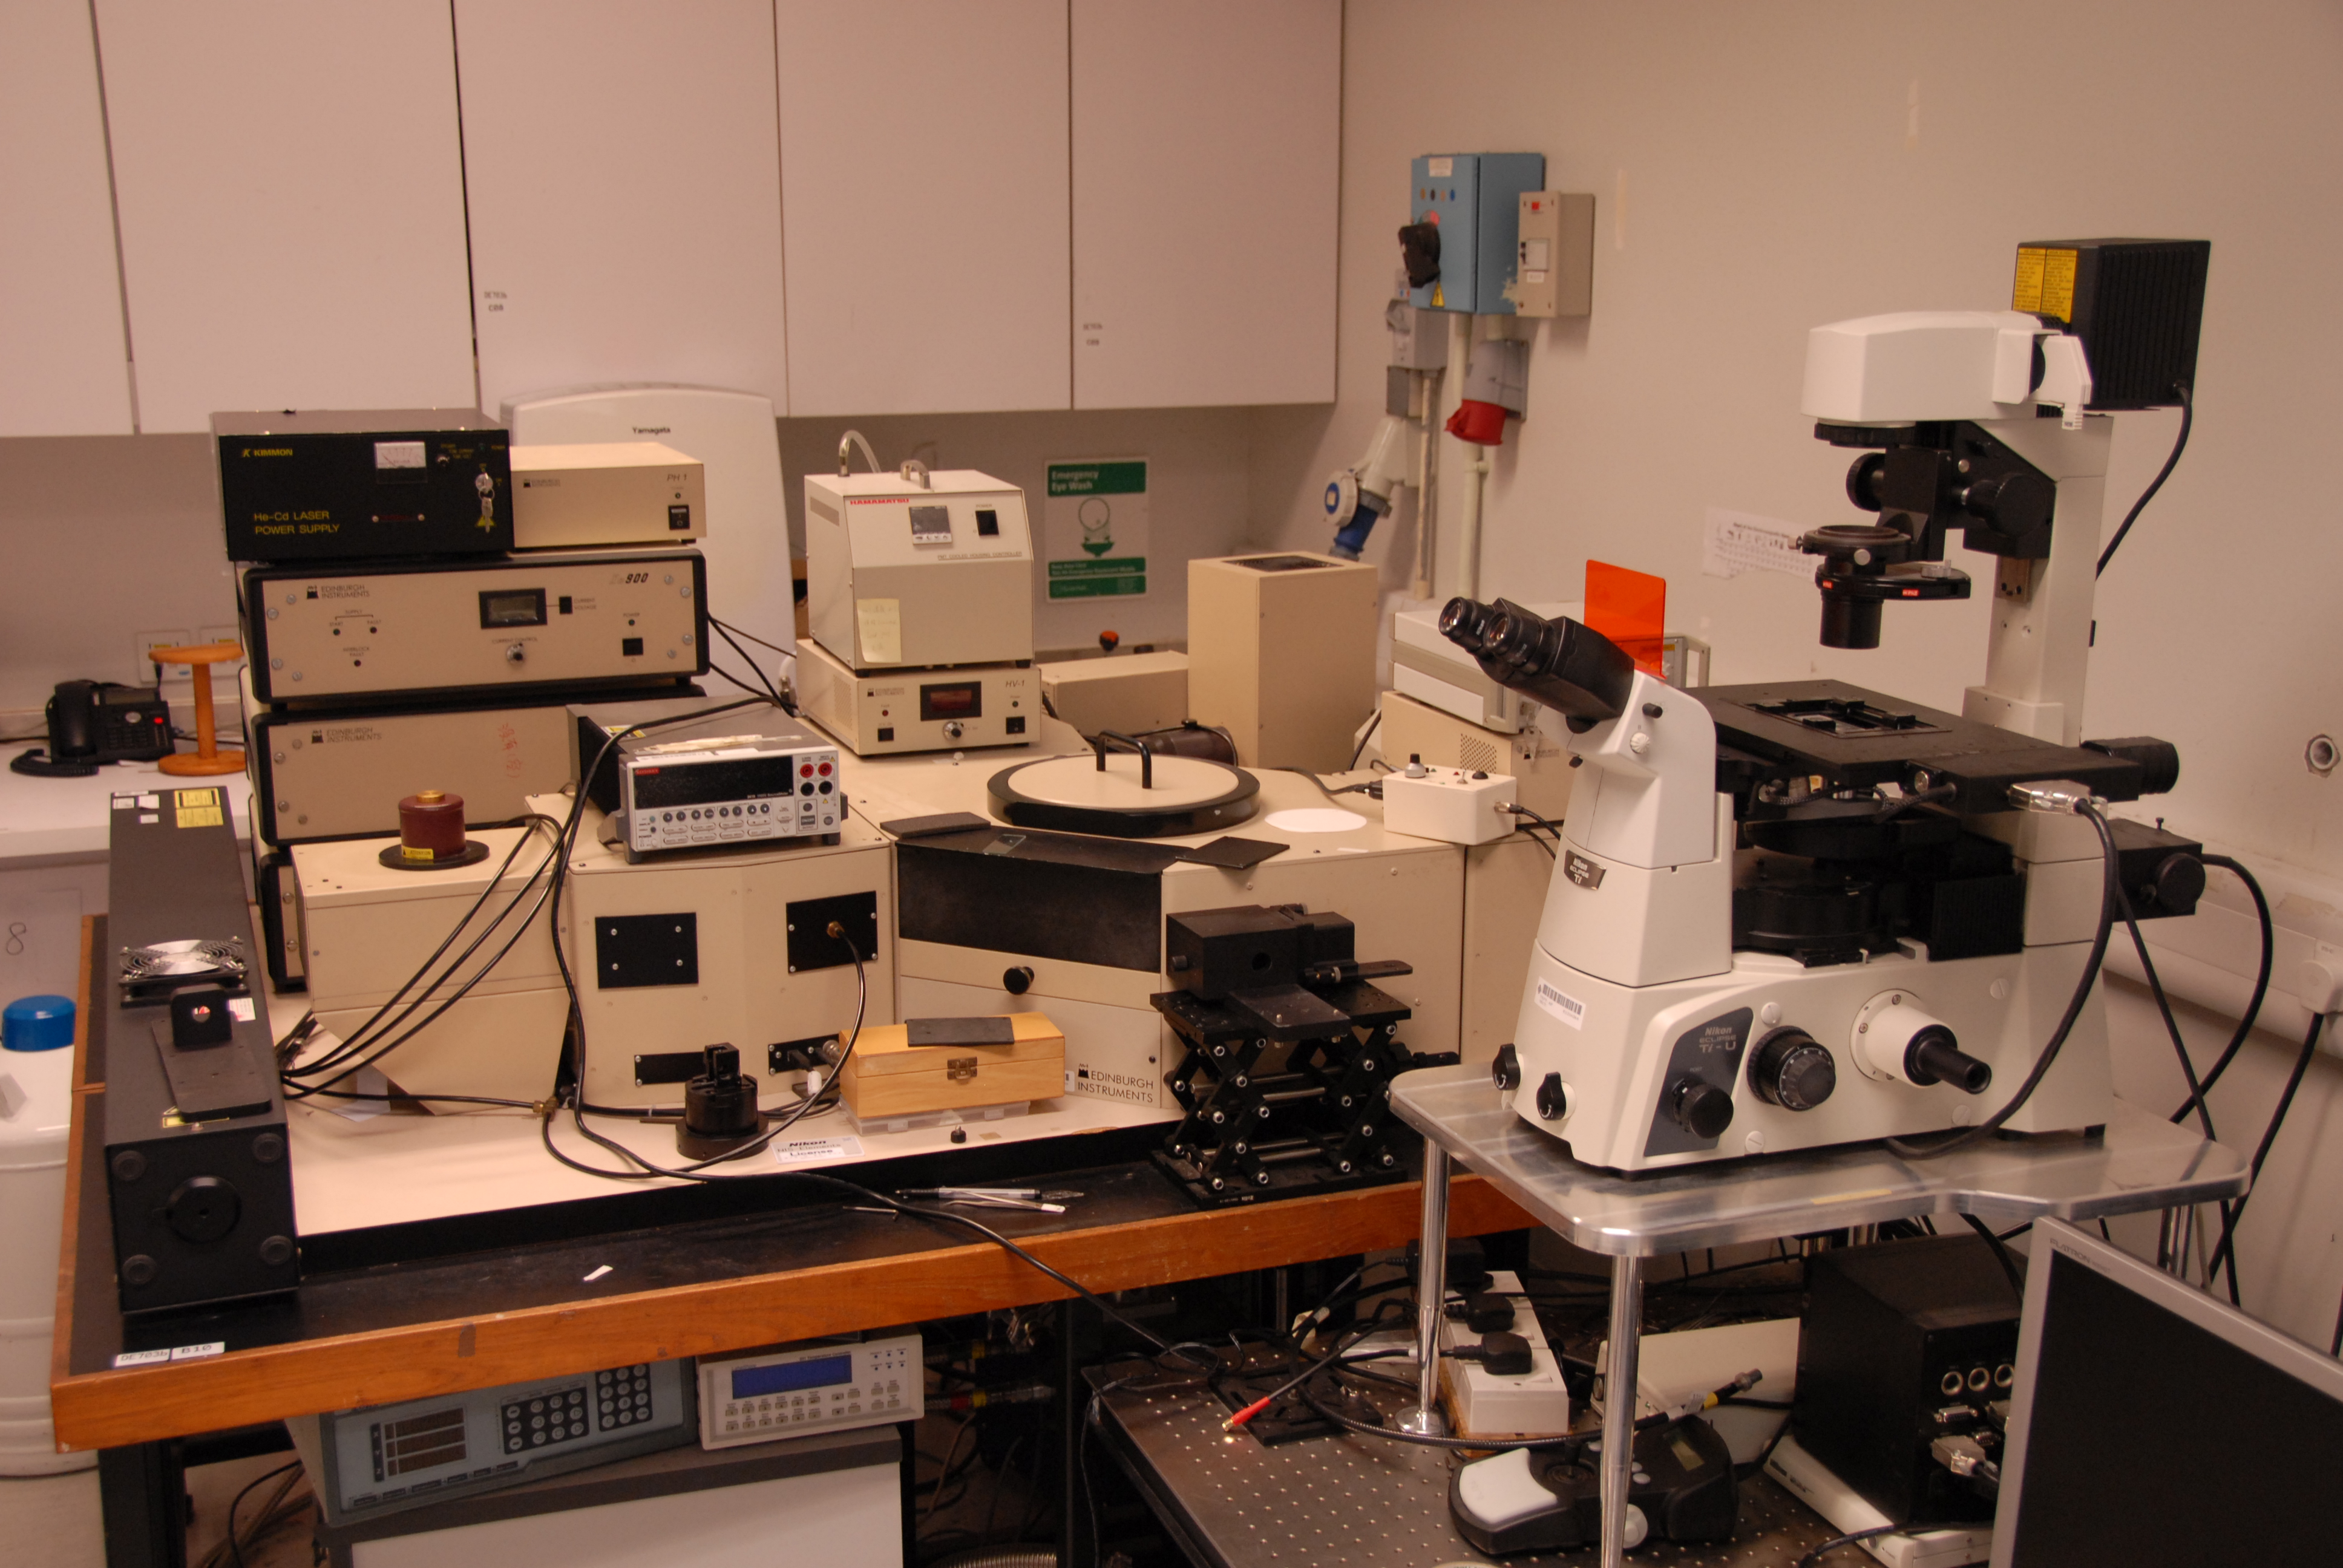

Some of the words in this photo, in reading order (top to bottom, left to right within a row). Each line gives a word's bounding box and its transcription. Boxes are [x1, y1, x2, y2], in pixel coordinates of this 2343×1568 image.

[632, 426, 671, 435] Yamagata
[254, 448, 293, 457] KIMMON
[1052, 471, 1099, 481] Emergency
[1052, 482, 1067, 492] Eye
[1069, 481, 1093, 491] Wash
[254, 512, 289, 521] He-Cd
[293, 510, 330, 521] LASER
[255, 524, 295, 535] POWER
[299, 523, 340, 534] SUPPLY
[321, 584, 365, 593] EDINBURGH
[322, 590, 370, 599] INSTRUMENTS
[1005, 679, 1025, 688] HV-1
[326, 727, 373, 736] EDINBURGH
[327, 733, 382, 743] INSTRUMENTS
[1573, 857, 1588, 871] Nikon
[6, 922, 27, 955] 8
[1705, 1027, 1732, 1037] Nikon
[1699, 1034, 1737, 1043] ECLIPSE
[1091, 1070, 1154, 1089] EDINBURGH
[1078, 1081, 1153, 1103] INSTRUMENTS
[2050, 1237, 2091, 1264] FLATRON
